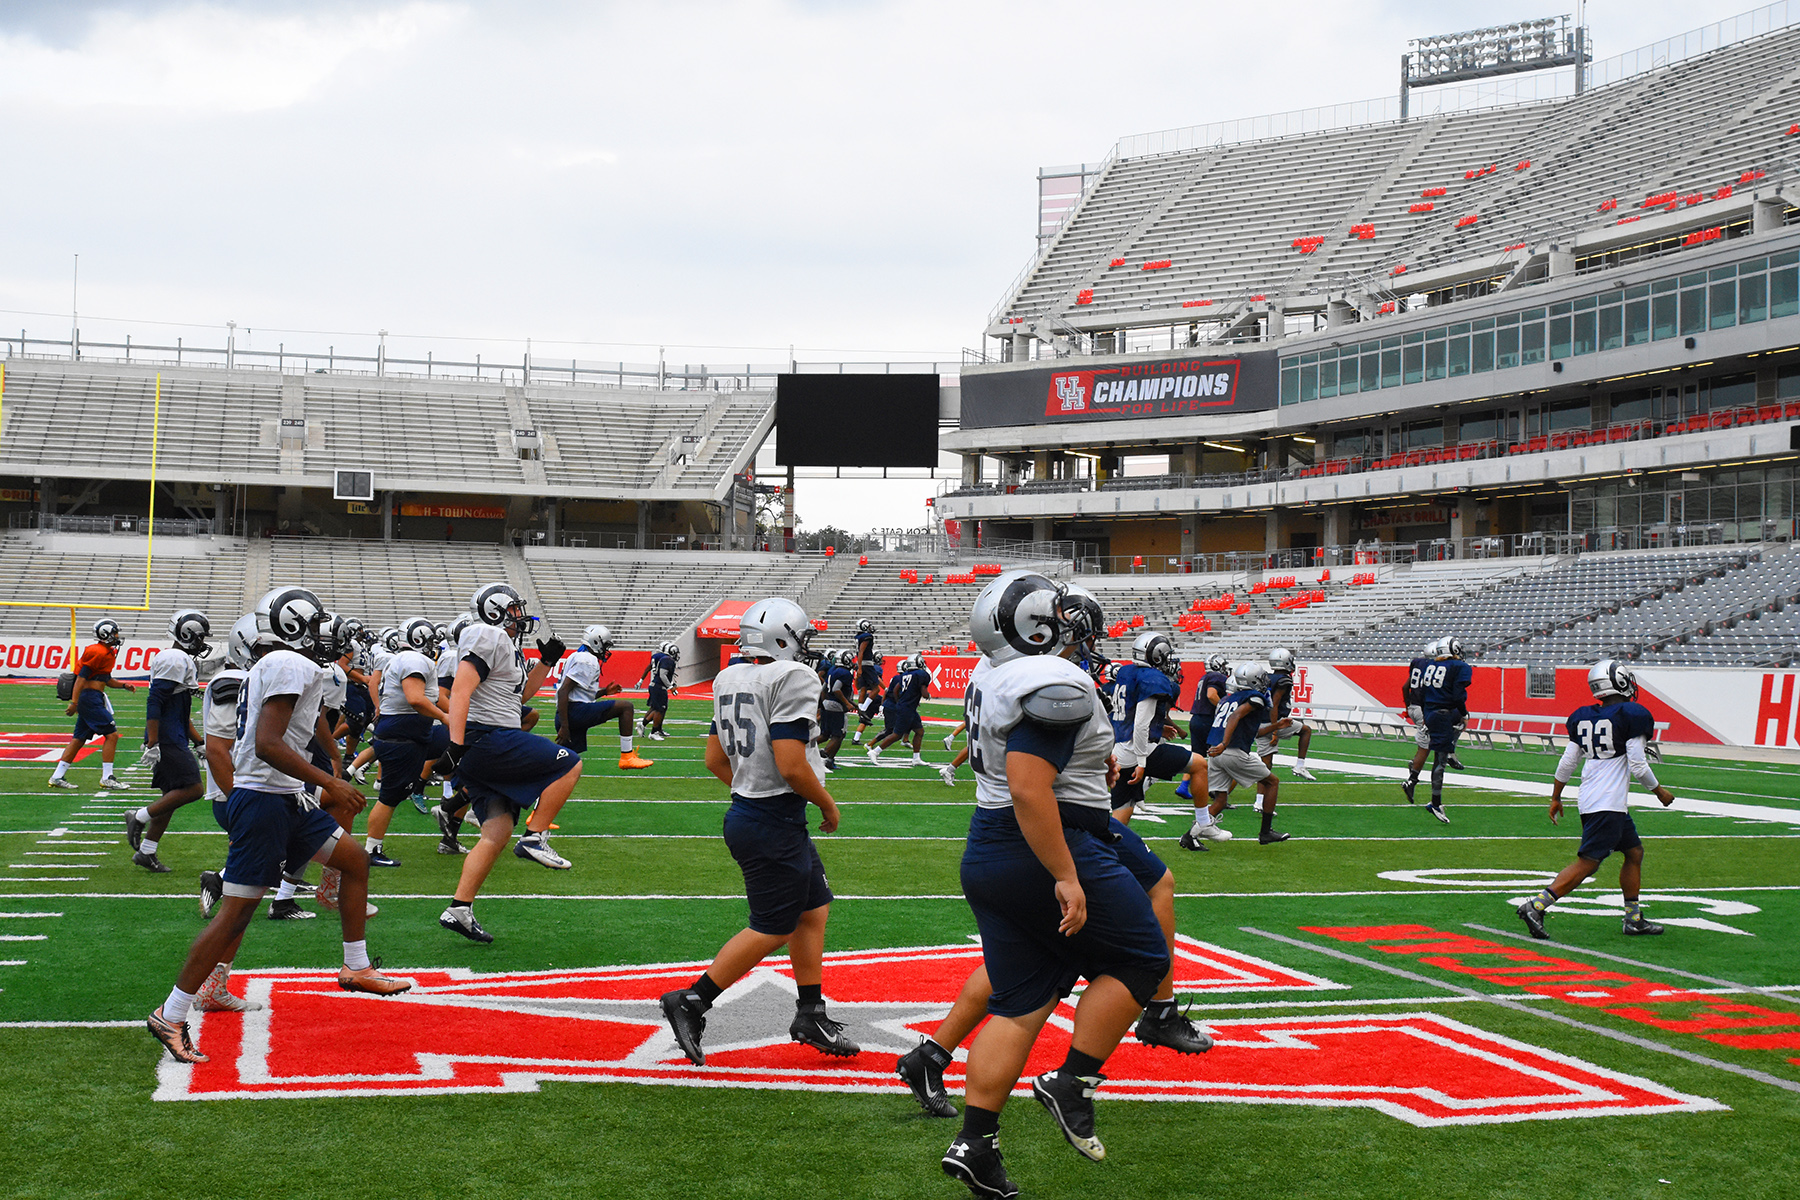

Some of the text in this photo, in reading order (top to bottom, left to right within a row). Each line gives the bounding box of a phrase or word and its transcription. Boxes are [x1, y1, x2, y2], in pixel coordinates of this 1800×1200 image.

[1120, 360, 1201, 377] BUILDING
[1093, 372, 1229, 404] CHAMPIONS
[1120, 400, 1199, 415] FOR LIFE
[423, 506, 472, 518] H-TOWN
[1413, 509, 1446, 523] GRILL
[945, 668, 973, 679] TICKE
[1423, 664, 1447, 689] 89
[1754, 674, 1800, 747] H
[719, 692, 757, 758] 55
[1577, 718, 1617, 759] 33
